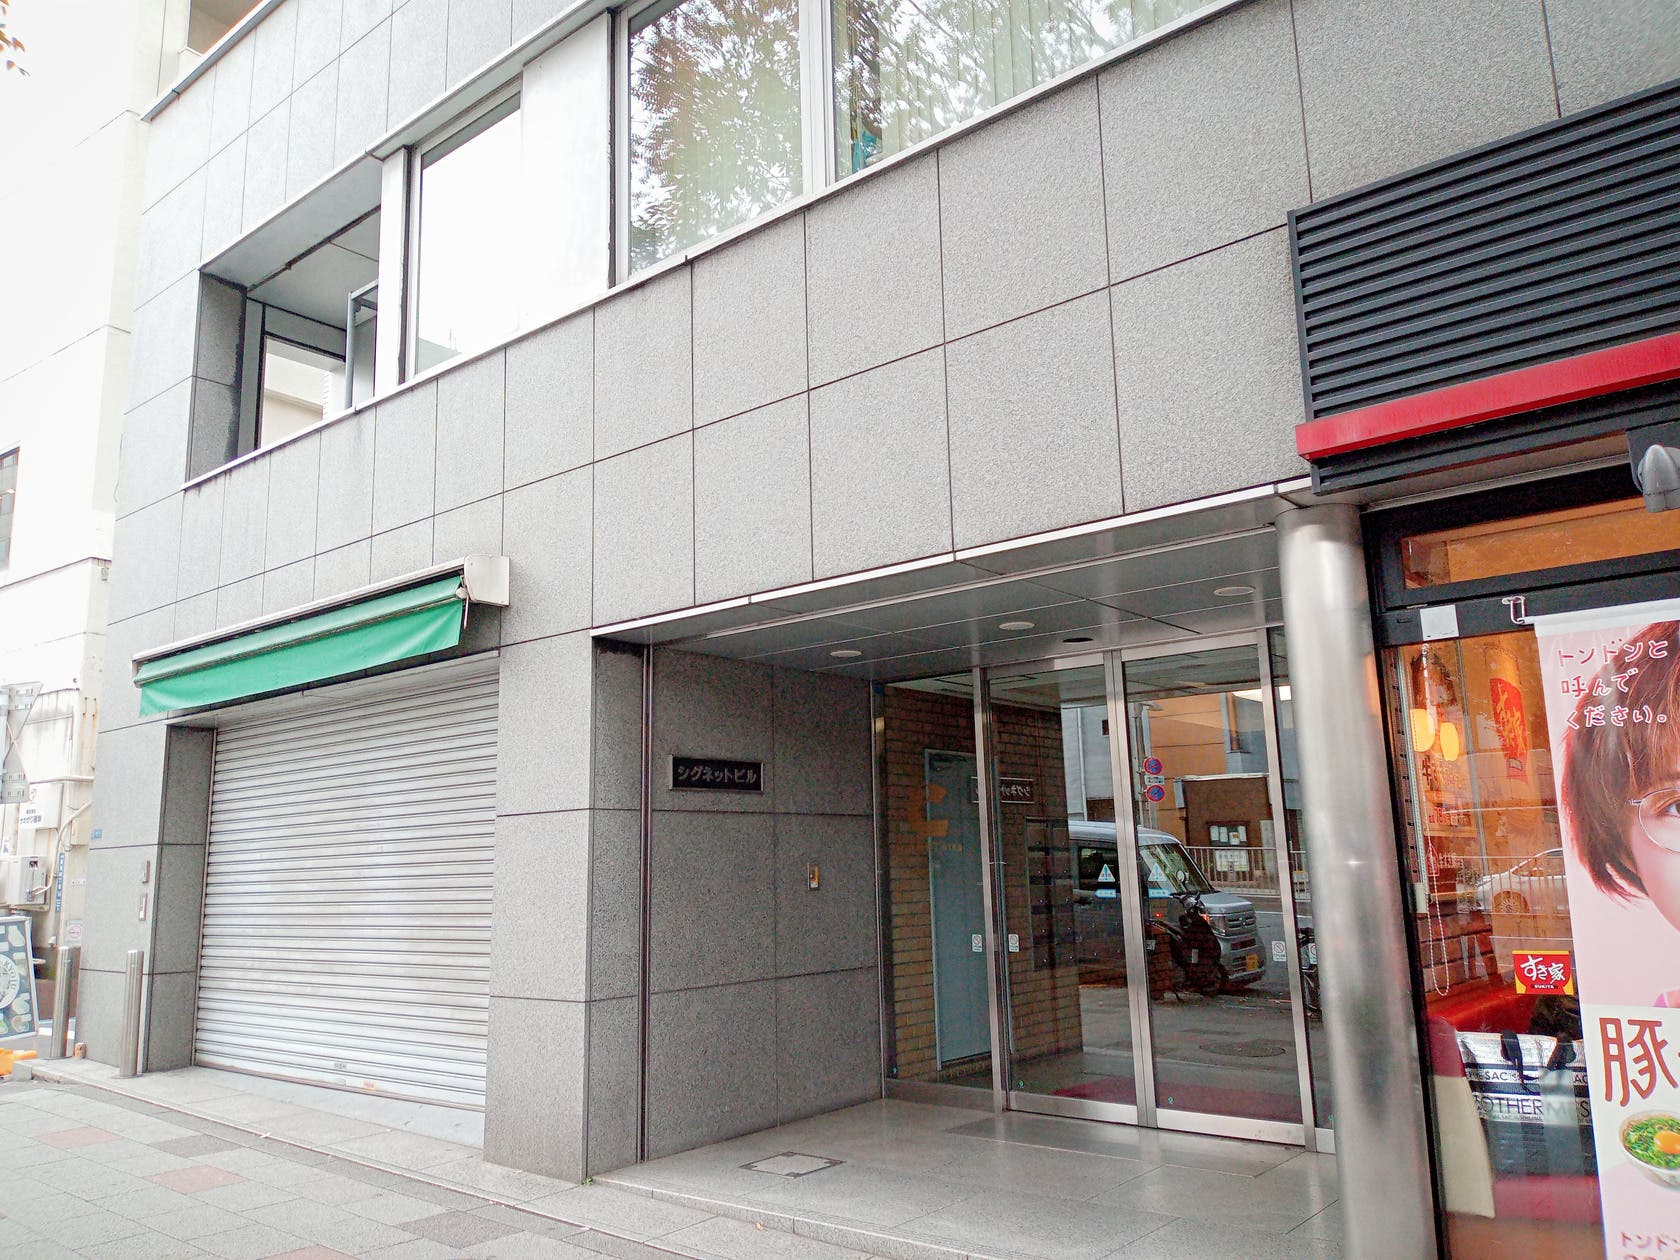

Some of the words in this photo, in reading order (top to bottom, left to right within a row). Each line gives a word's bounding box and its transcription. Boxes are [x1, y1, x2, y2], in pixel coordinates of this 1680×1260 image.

[1558, 637, 1668, 668] トンドンと
[1561, 667, 1638, 698] 呼んで
[1566, 705, 1667, 729] ください。
[677, 764, 757, 784] シグネットビル
[1520, 954, 1566, 984] すき家
[1599, 1017, 1680, 1107] 豚
